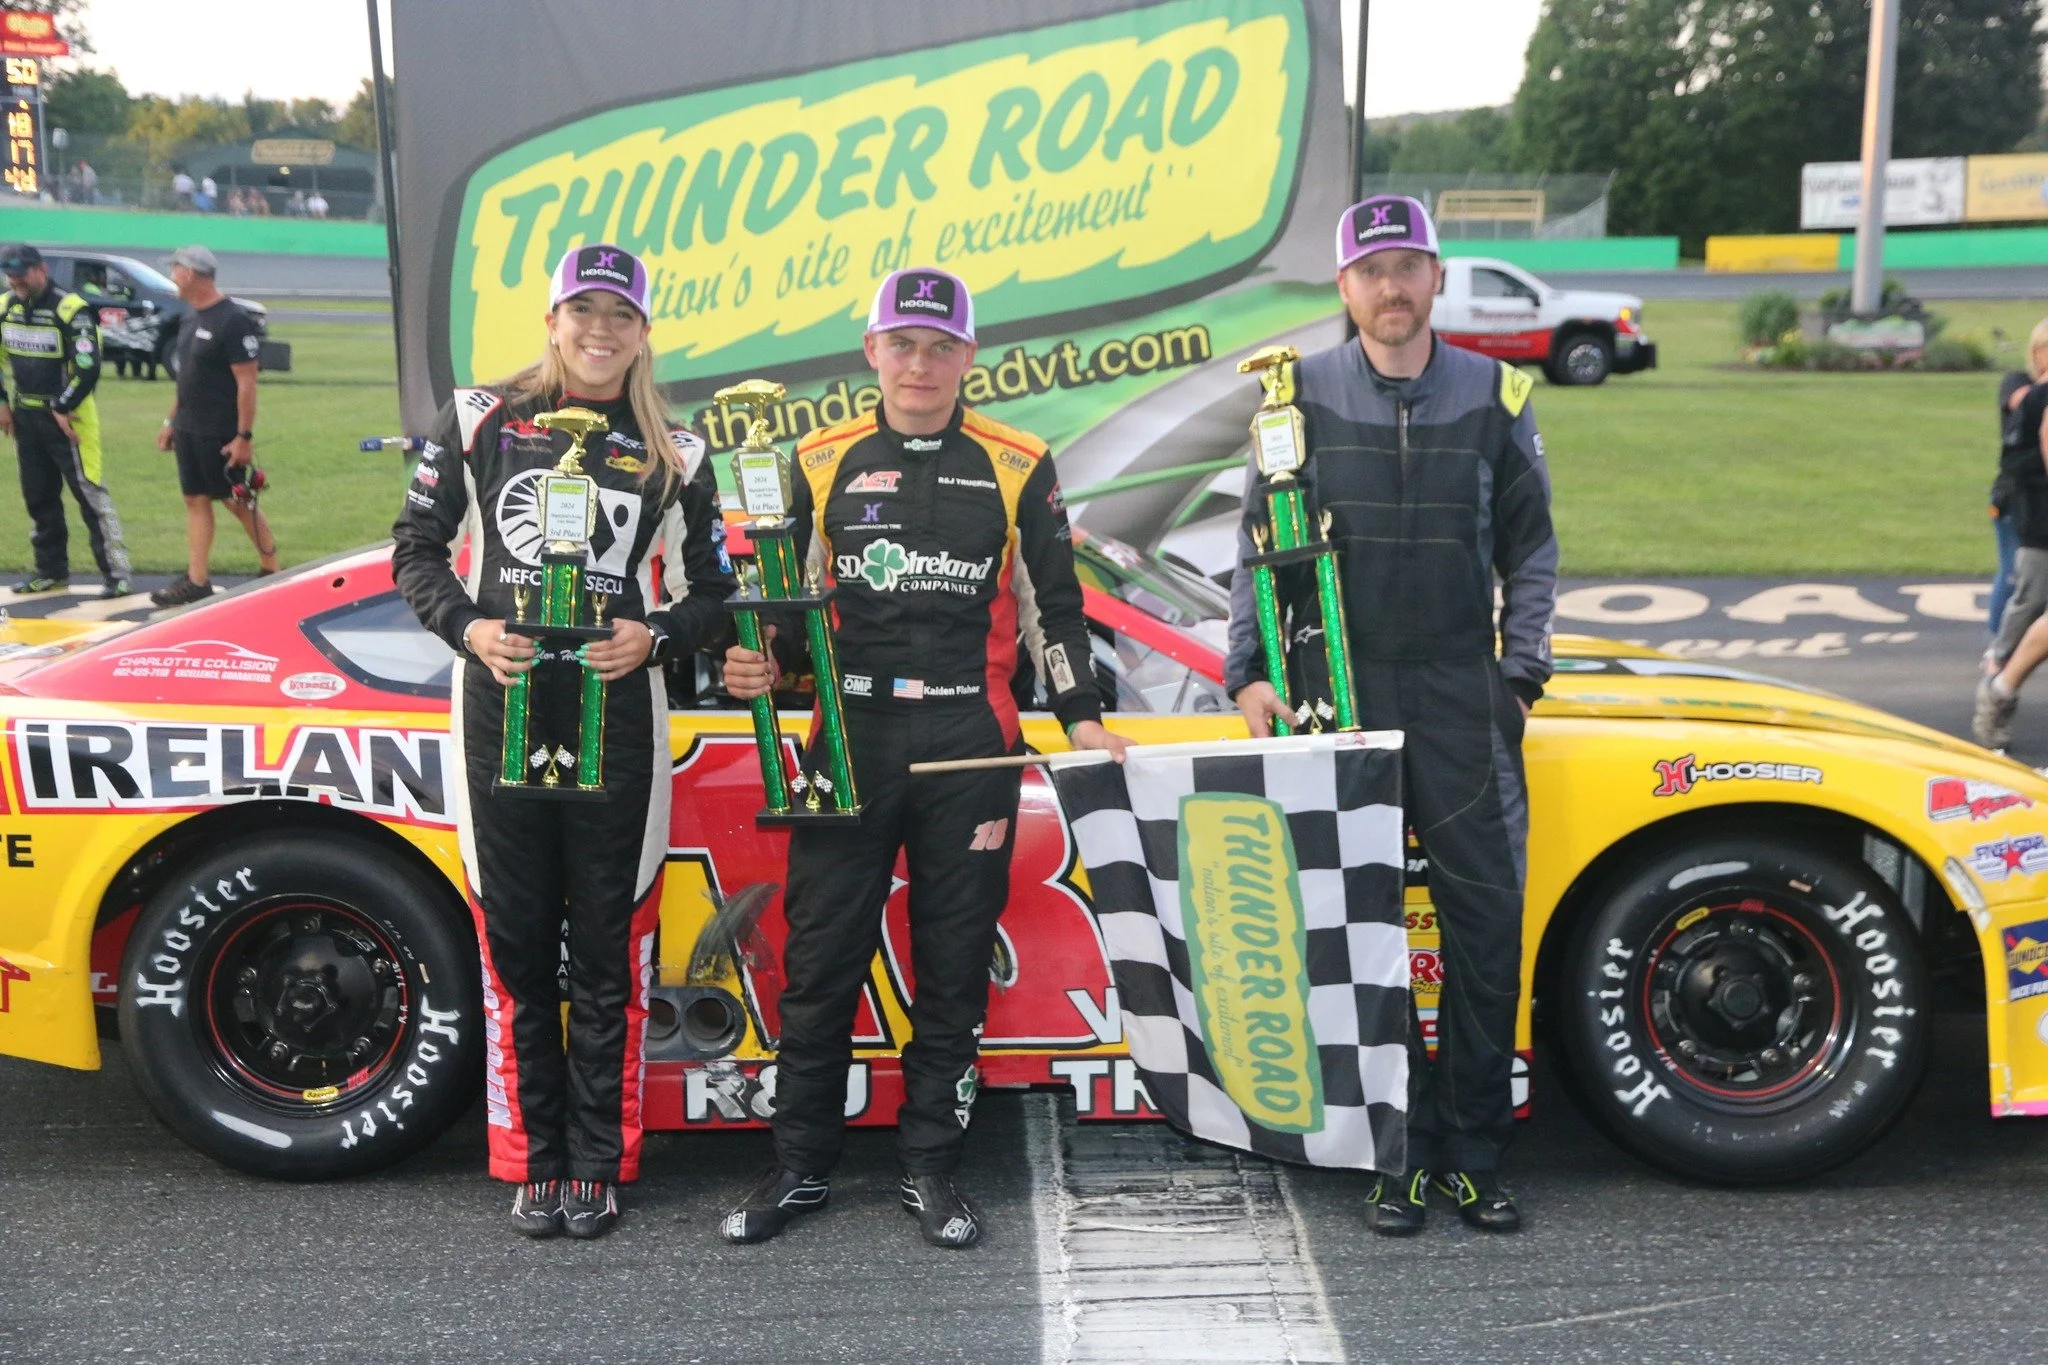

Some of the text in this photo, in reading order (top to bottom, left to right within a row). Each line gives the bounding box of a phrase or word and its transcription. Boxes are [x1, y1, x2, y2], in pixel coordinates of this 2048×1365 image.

[501, 46, 1240, 288] THUNDER ROAD
[777, 232, 850, 299] site
[870, 207, 916, 274] of
[581, 268, 629, 283] HOOSIER
[900, 299, 948, 312] HOOSIER
[805, 449, 835, 467] OMP
[999, 451, 1030, 470] OMP
[938, 477, 996, 489] R&J TRUCKING
[563, 529, 582, 538] Place
[837, 550, 993, 580] SD Ireland
[500, 567, 622, 594] NEFC SECU
[900, 579, 977, 595] COMPANIES
[118, 656, 278, 672] CHARLOTTE COLLISION
[844, 677, 872, 693] OMP
[924, 685, 980, 696] Kaiden Fisher
[26, 724, 446, 815] IRELAN
[1689, 762, 1822, 784] HOOSIER
[968, 818, 1009, 850] 18
[136, 867, 259, 1018] Hoosier
[1223, 813, 1301, 1113] THUNDER ROAD
[1823, 891, 1916, 1069] Hoosier
[1587, 938, 1672, 1116] Hoosier
[340, 995, 461, 1149] Hoosier
